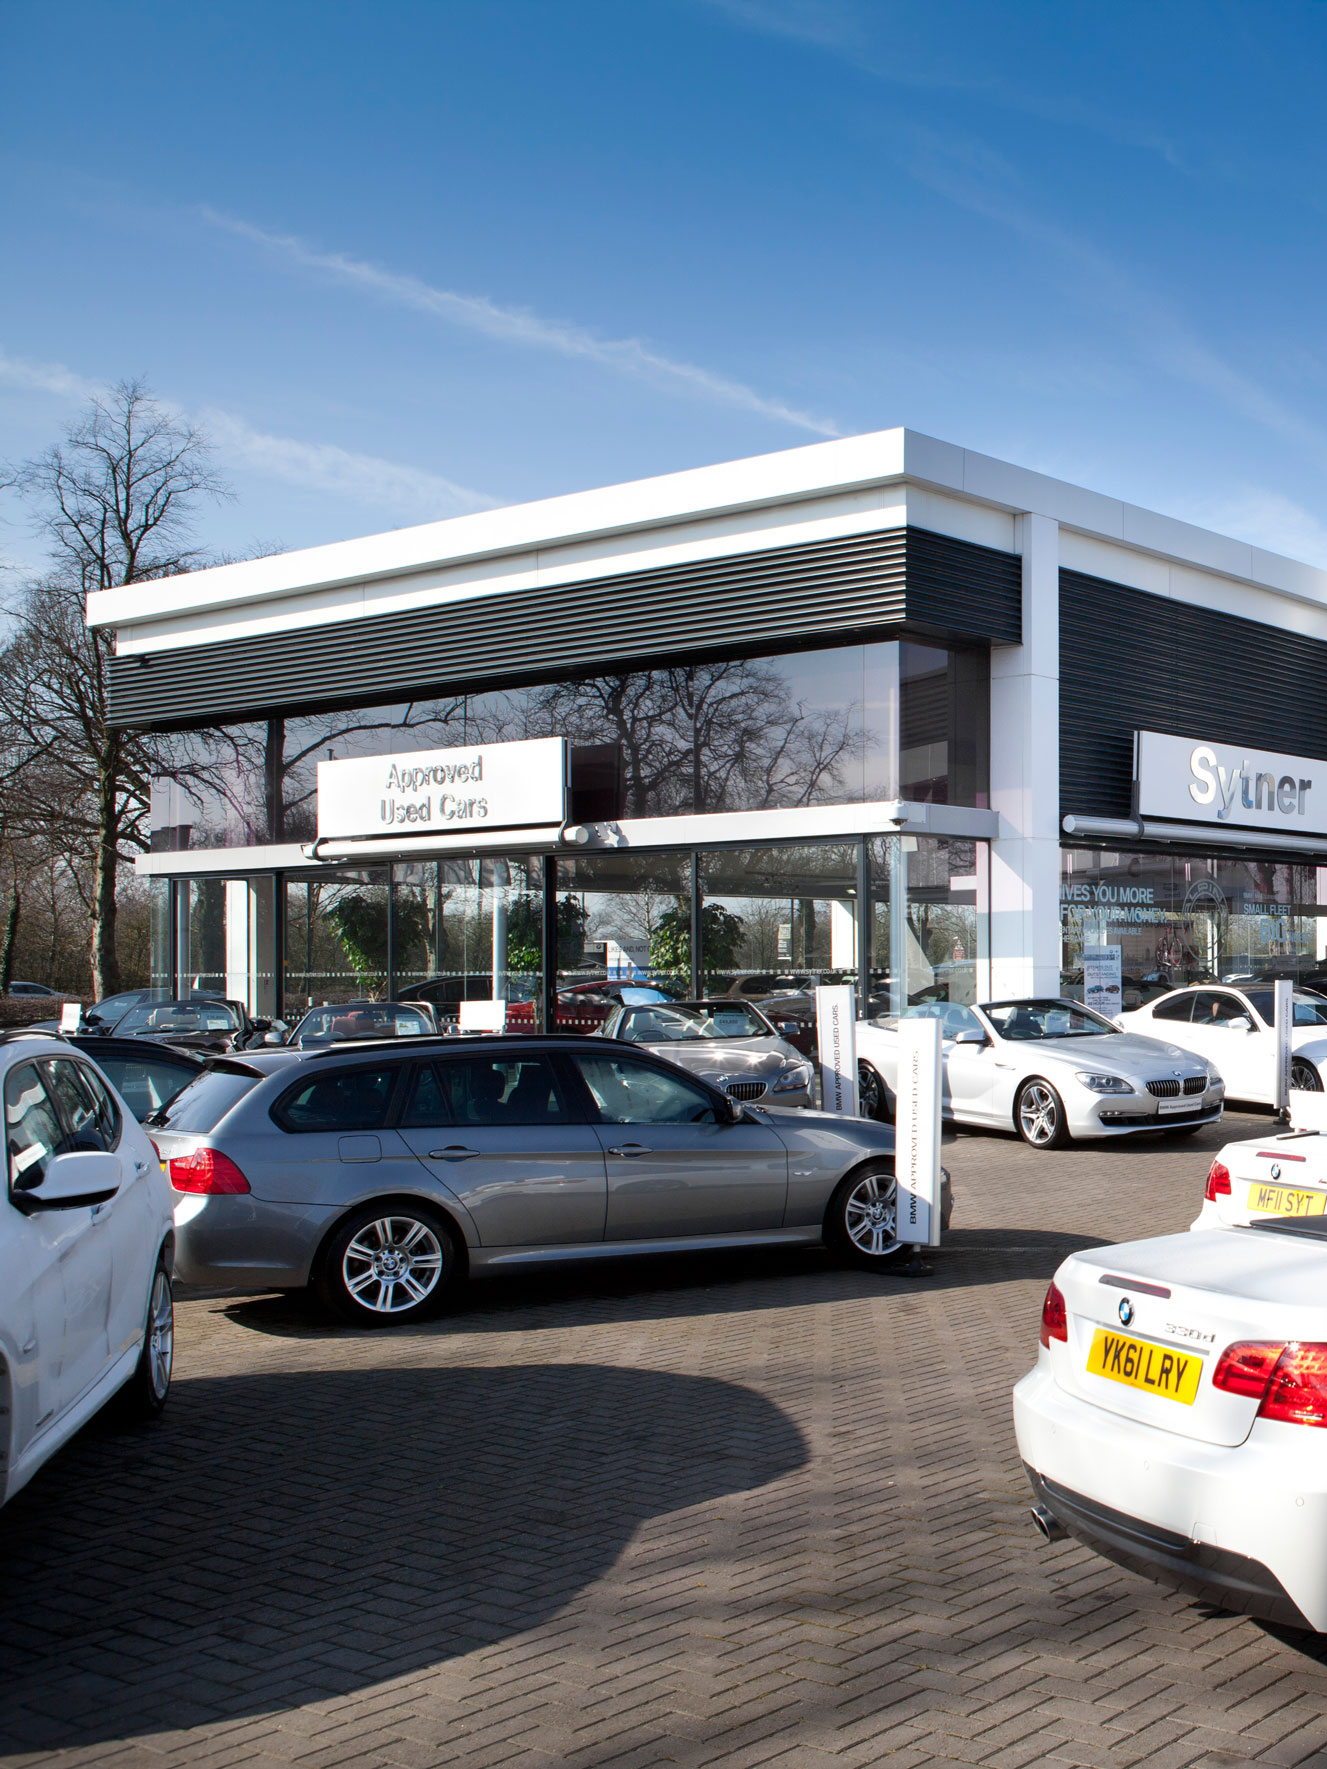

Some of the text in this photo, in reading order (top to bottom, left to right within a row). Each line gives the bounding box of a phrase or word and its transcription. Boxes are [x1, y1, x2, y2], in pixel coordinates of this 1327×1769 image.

[385, 755, 483, 793] Approved
[1188, 746, 1312, 820] Sytner
[380, 793, 488, 825] Used Cars
[1059, 884, 1155, 904] IVES YOU MORE
[1124, 907, 1168, 924] MONEY.
[1243, 903, 1292, 916] SMALL FLEET
[1260, 917, 1287, 943] BIG
[717, 967, 763, 976] www.sytner.co.uk
[790, 967, 838, 976] www.sytner.co.uk
[831, 1003, 839, 1025] CARS.
[832, 1026, 841, 1047] USED
[834, 1049, 842, 1090] APPROVED
[911, 1088, 919, 1121] USED
[910, 1123, 919, 1190] APPROVED
[909, 1193, 917, 1225] BMW
[1285, 1193, 1314, 1217] SYT
[1102, 1335, 1189, 1393] YK61 LRY
